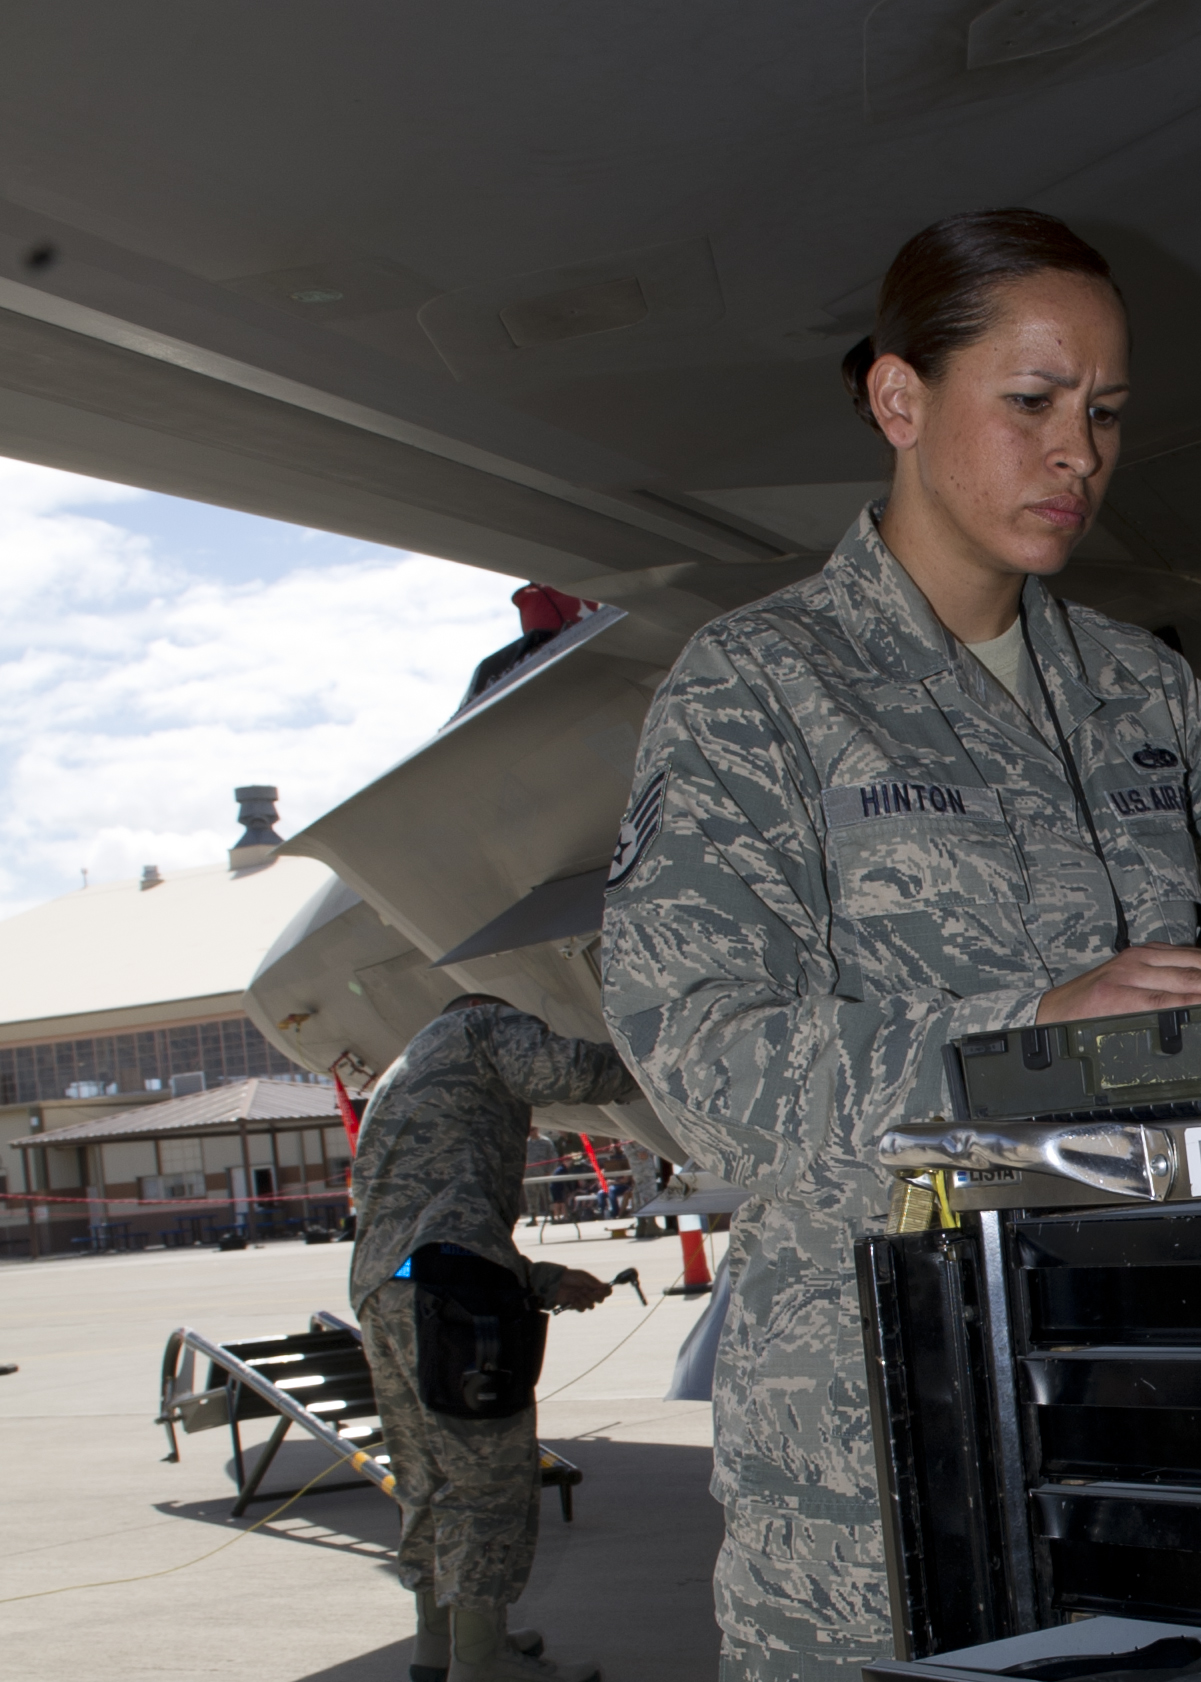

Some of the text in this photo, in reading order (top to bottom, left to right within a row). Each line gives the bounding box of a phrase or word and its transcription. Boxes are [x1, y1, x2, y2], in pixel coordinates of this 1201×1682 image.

[860, 783, 966, 817] HINTON
[1110, 789, 1151, 815] U.S.
[1149, 785, 1182, 811] AIR
